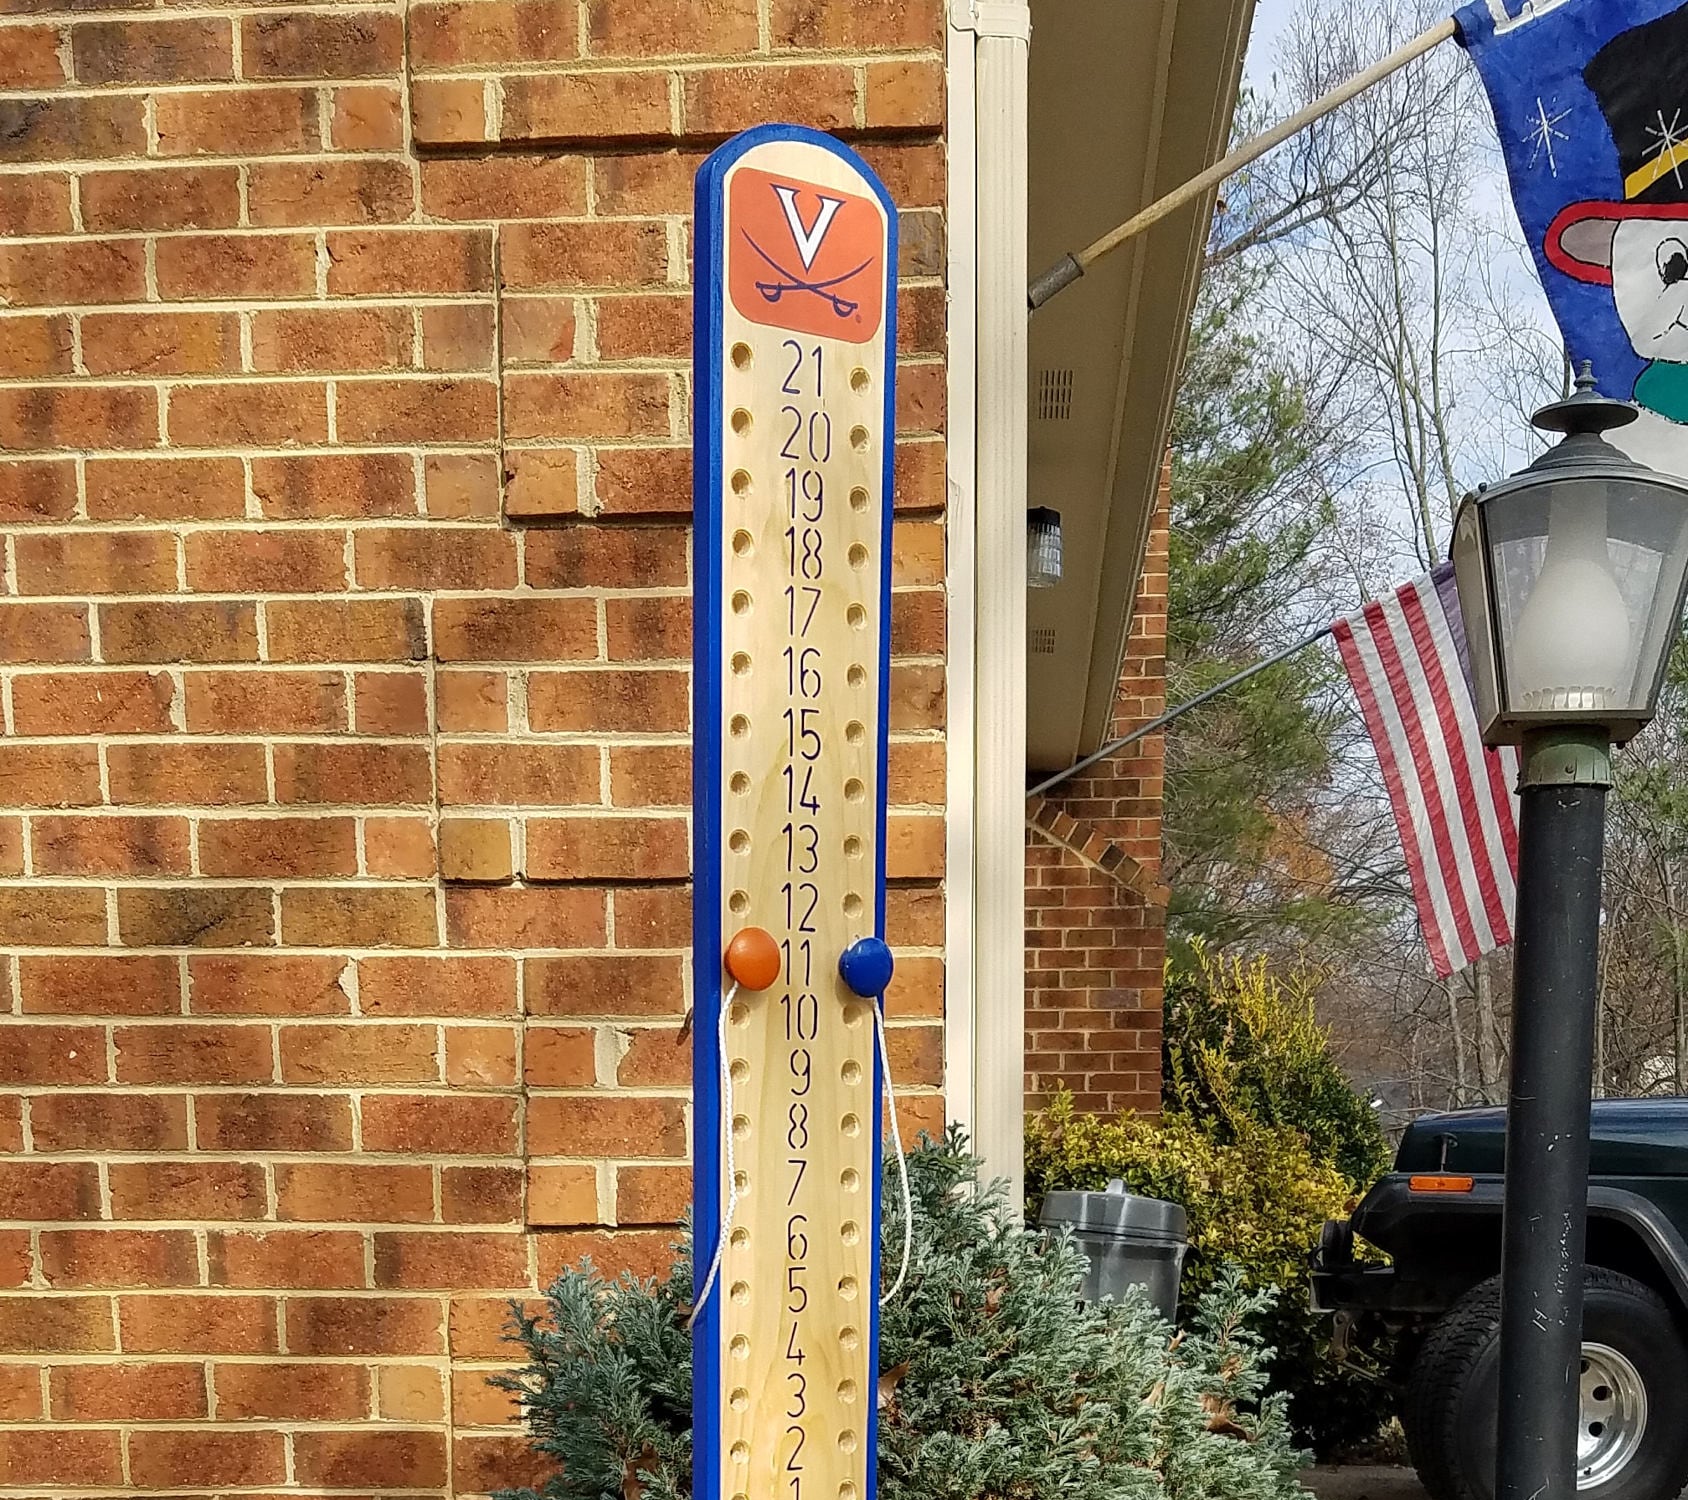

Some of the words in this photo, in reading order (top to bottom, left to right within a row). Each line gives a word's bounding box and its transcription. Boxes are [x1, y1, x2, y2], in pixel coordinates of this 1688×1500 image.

[770, 183, 847, 275] V
[782, 339, 823, 397] 21
[780, 405, 831, 463] 20
[785, 467, 824, 522] 19
[784, 525, 823, 580] 18
[784, 585, 822, 638] 17
[783, 646, 821, 698] 16
[783, 708, 821, 760] 15
[783, 764, 821, 816] 14
[782, 822, 819, 873] 13
[781, 882, 819, 932] 12
[781, 938, 811, 986] 11
[780, 993, 818, 1040] 10
[790, 1048, 811, 1095] 9
[787, 1103, 808, 1150] 8
[787, 1159, 808, 1206] 7
[787, 1214, 807, 1260] 6
[787, 1267, 807, 1313] 5
[786, 1321, 806, 1366] 4
[786, 1373, 806, 1418] 3
[786, 1425, 805, 1471] 2
